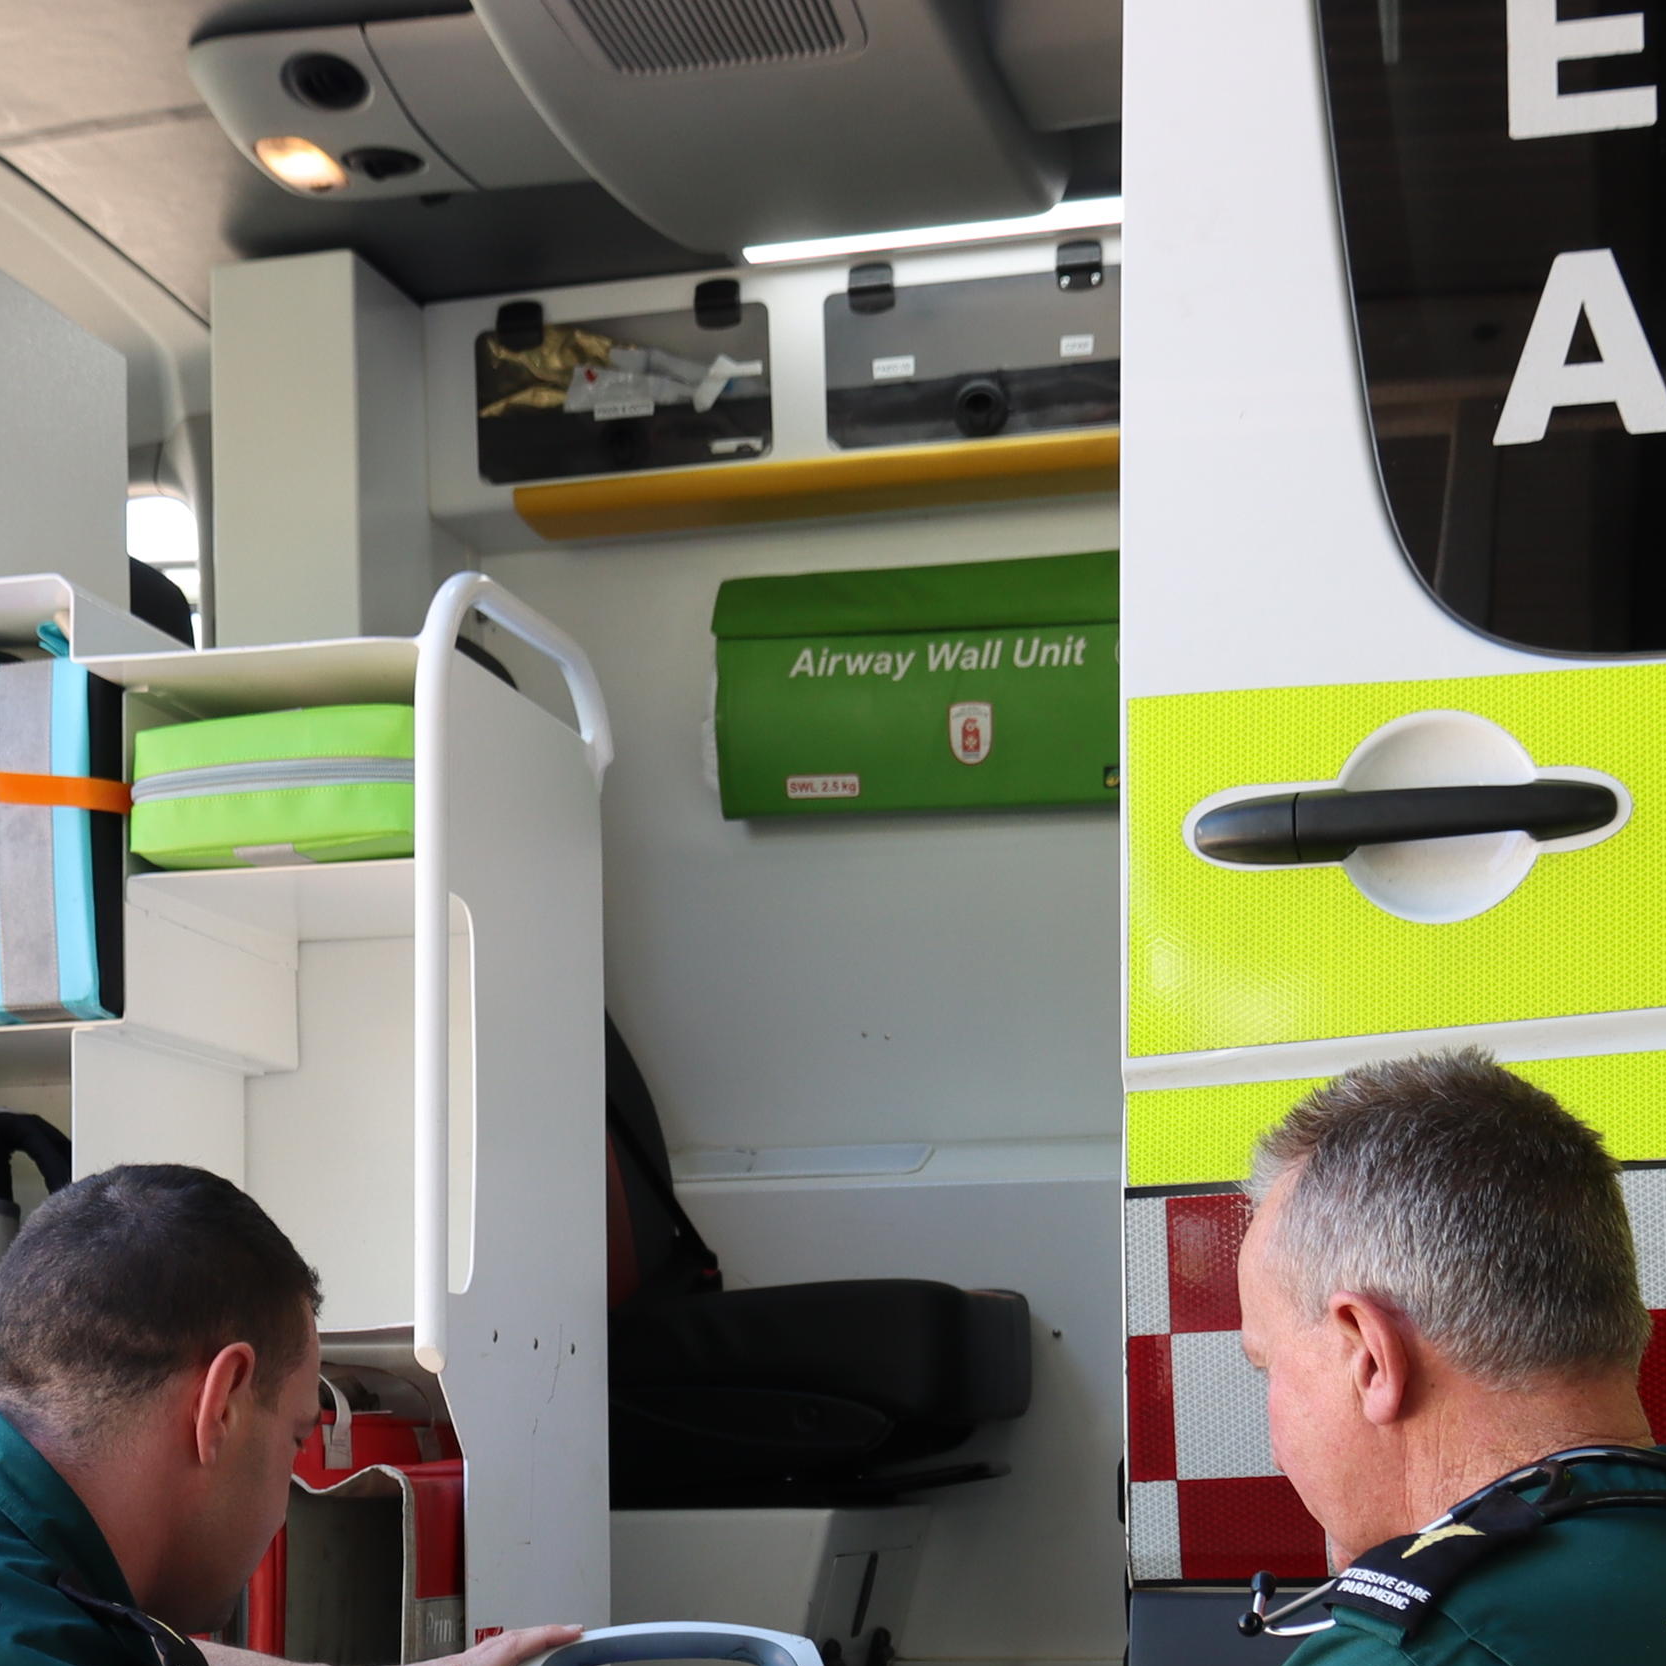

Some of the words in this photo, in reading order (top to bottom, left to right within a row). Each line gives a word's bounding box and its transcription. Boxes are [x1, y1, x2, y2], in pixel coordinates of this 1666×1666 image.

[788, 648, 916, 682] Airway
[927, 639, 1003, 672] Wall
[1013, 634, 1087, 668] Unit
[789, 782, 818, 794] SWL
[1336, 1579, 1410, 1611] PARAMEDIC
[1394, 1580, 1432, 1604] CARE
